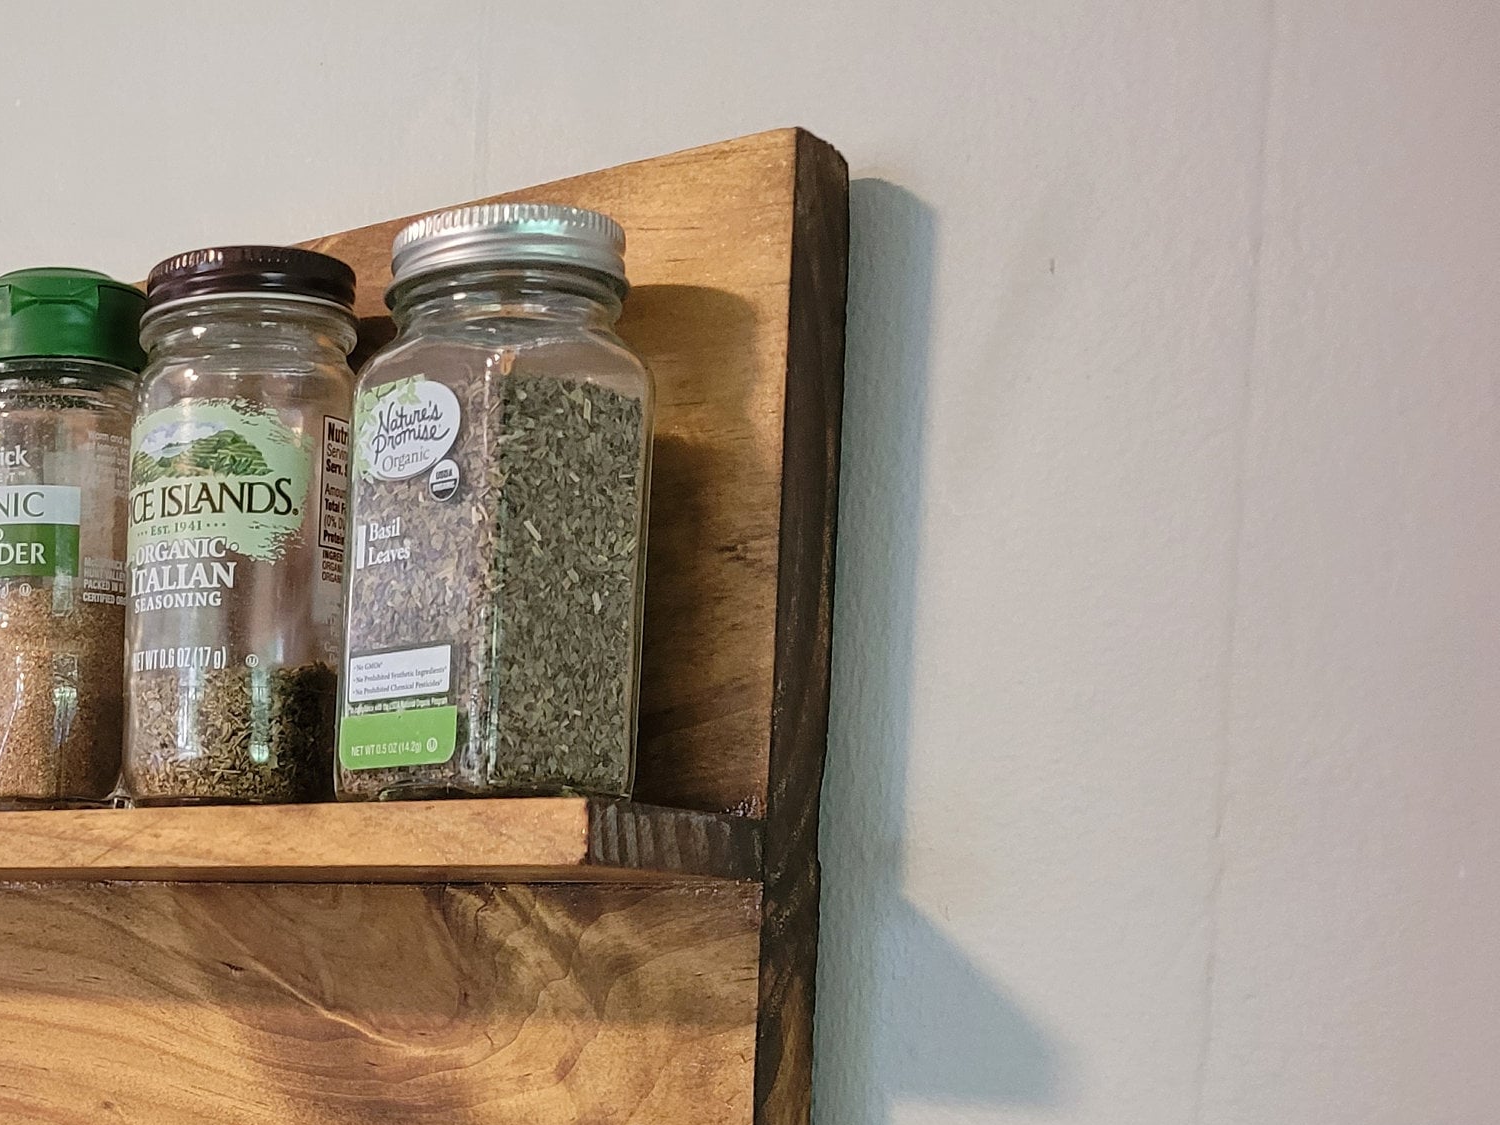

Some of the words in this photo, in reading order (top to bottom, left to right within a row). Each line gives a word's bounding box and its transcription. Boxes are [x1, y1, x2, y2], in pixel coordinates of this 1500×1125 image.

[378, 401, 443, 435] Nature's
[372, 428, 450, 465] Promise
[326, 459, 343, 477] Serv.
[382, 446, 430, 473] Organic
[325, 498, 340, 512] Total
[174, 520, 202, 533] 1941
[368, 517, 401, 542] Basil
[136, 537, 227, 565] ORGANIC
[367, 546, 411, 566] Leaves
[84, 579, 110, 591] PACKED
[131, 561, 237, 598] ITALIAN
[83, 592, 116, 604] CERTIFIED
[134, 590, 222, 614] SEASONING
[160, 647, 175, 670] 0.6
[177, 647, 191, 669] OZ
[213, 646, 227, 670] g)
[351, 745, 363, 757] NET
[365, 744, 375, 756] WT
[375, 743, 387, 755] 0.5
[388, 743, 397, 754] OZ
